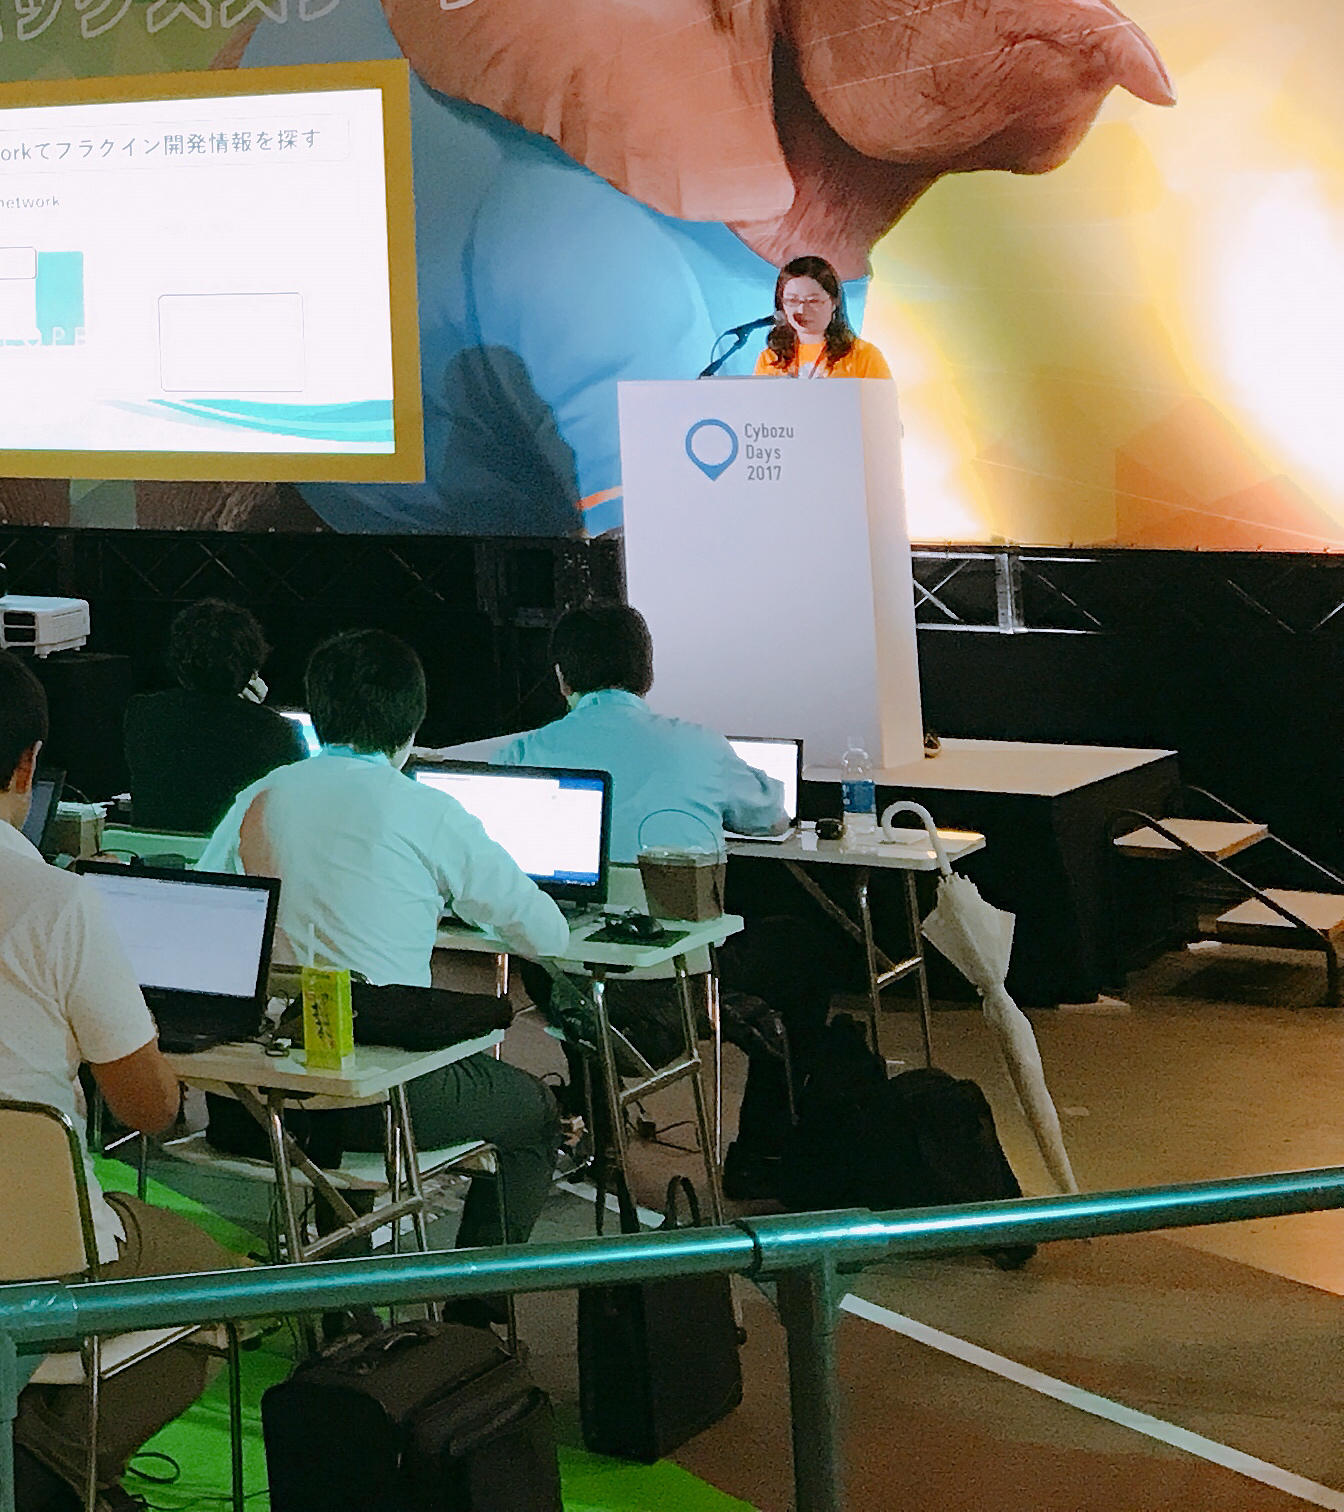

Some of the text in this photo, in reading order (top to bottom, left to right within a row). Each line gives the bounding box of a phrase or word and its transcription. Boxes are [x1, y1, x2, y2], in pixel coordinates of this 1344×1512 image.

[744, 422, 795, 442] Cybozu
[746, 444, 782, 464] Days
[747, 465, 782, 481] 2017
